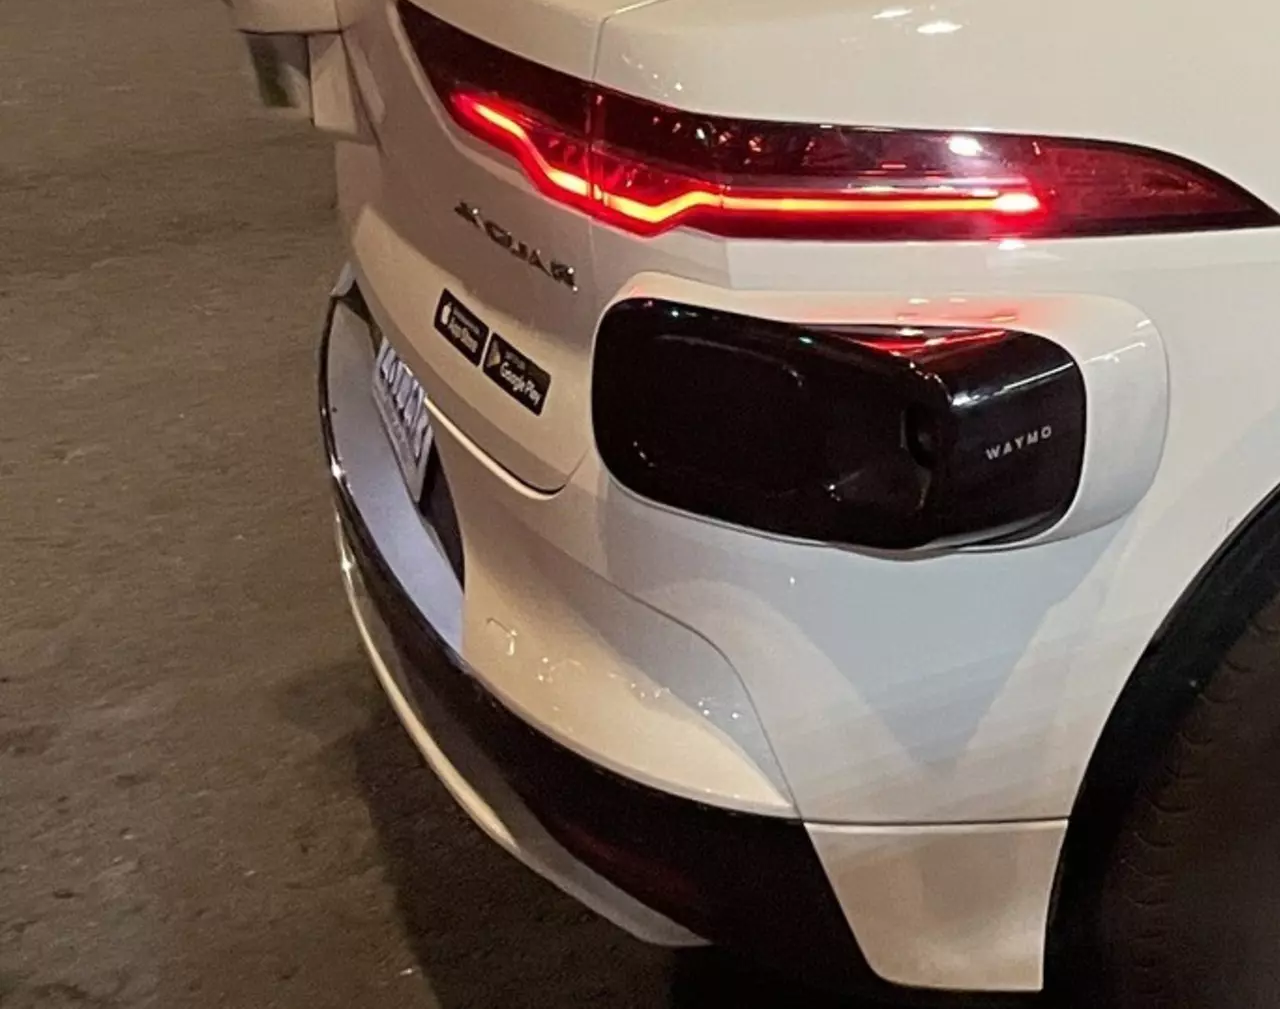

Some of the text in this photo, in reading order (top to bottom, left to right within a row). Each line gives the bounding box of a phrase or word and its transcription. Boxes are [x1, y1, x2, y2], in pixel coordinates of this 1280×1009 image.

[501, 361, 542, 406] Google Play
[985, 424, 1052, 460] WAYMO
